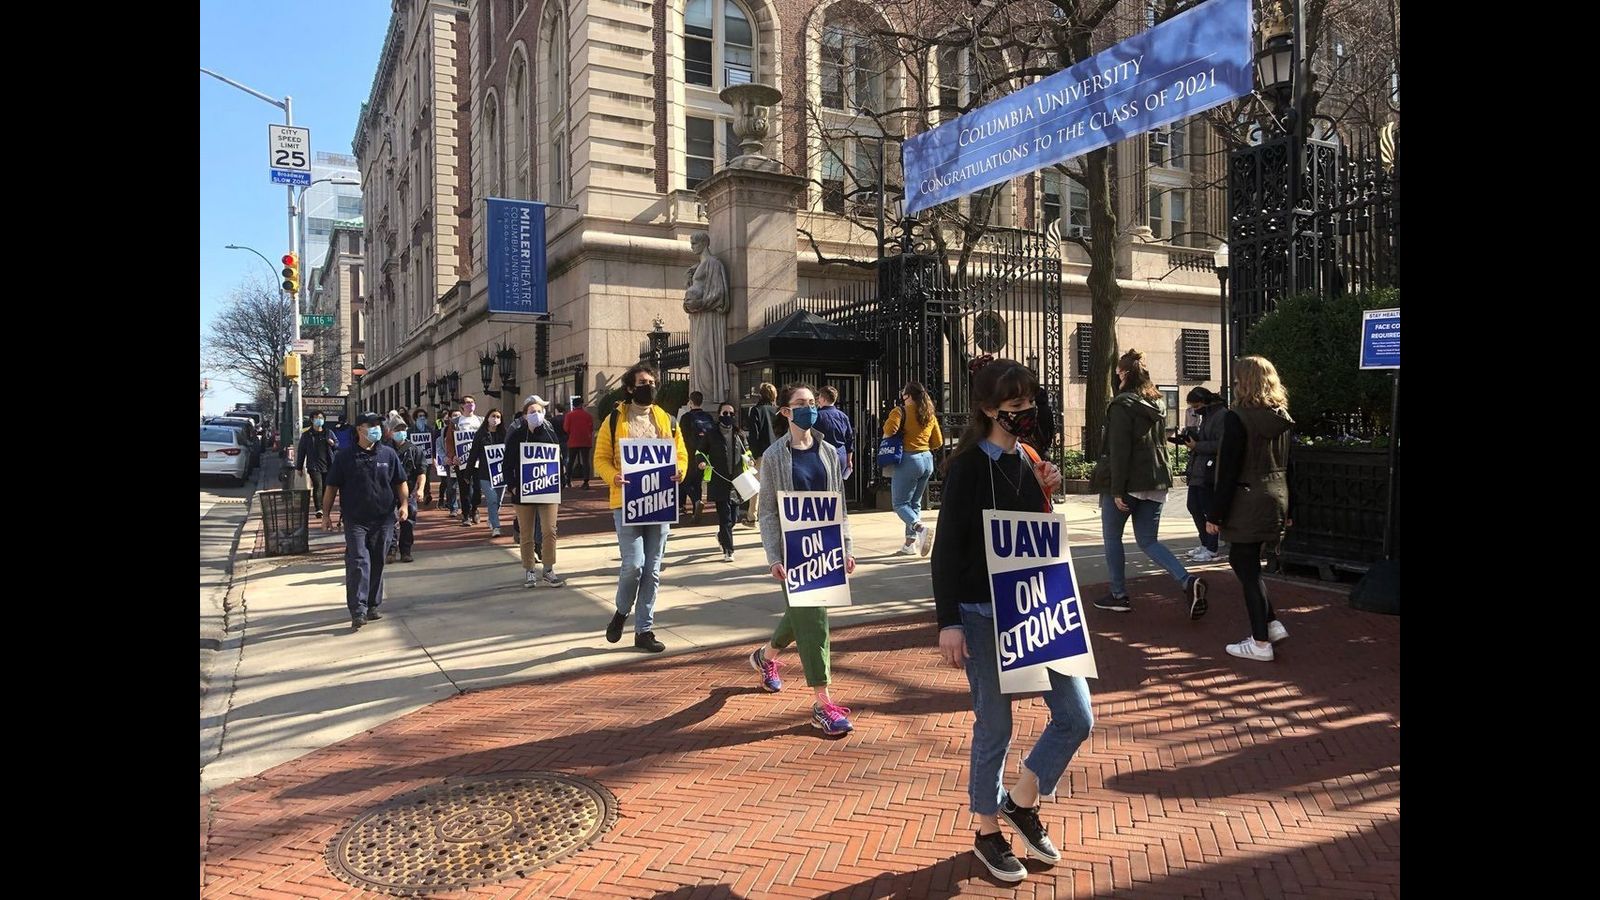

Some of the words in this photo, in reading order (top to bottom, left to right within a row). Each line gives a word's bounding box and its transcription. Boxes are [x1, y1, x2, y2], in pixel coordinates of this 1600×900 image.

[958, 106, 1034, 147] COLUMBIA
[1037, 55, 1145, 115] UNIVERSITY
[278, 135, 302, 143] SPEED
[919, 144, 1029, 195] CONGRATULATIONS
[1033, 135, 1052, 152] TO
[1056, 121, 1085, 143] THE
[1089, 101, 1139, 131] CLASS
[1144, 93, 1169, 112] OF
[1173, 67, 1217, 102] 2021
[275, 150, 305, 167] 25
[303, 316, 310, 325] W
[312, 316, 325, 325] 116
[412, 434, 430, 442] UAW
[463, 442, 473, 453] ON
[524, 445, 557, 460] UAW
[623, 445, 672, 465] UAW
[532, 464, 547, 479] ON
[641, 471, 660, 495] ON
[522, 473, 559, 495] STRIKE
[627, 487, 675, 520] STRIKE
[783, 496, 838, 522] UAW
[801, 530, 824, 558] ON
[990, 519, 1060, 558] UAW
[787, 547, 843, 590] STRIKE
[1015, 571, 1047, 615] ON
[1000, 596, 1082, 667] STRIKE
